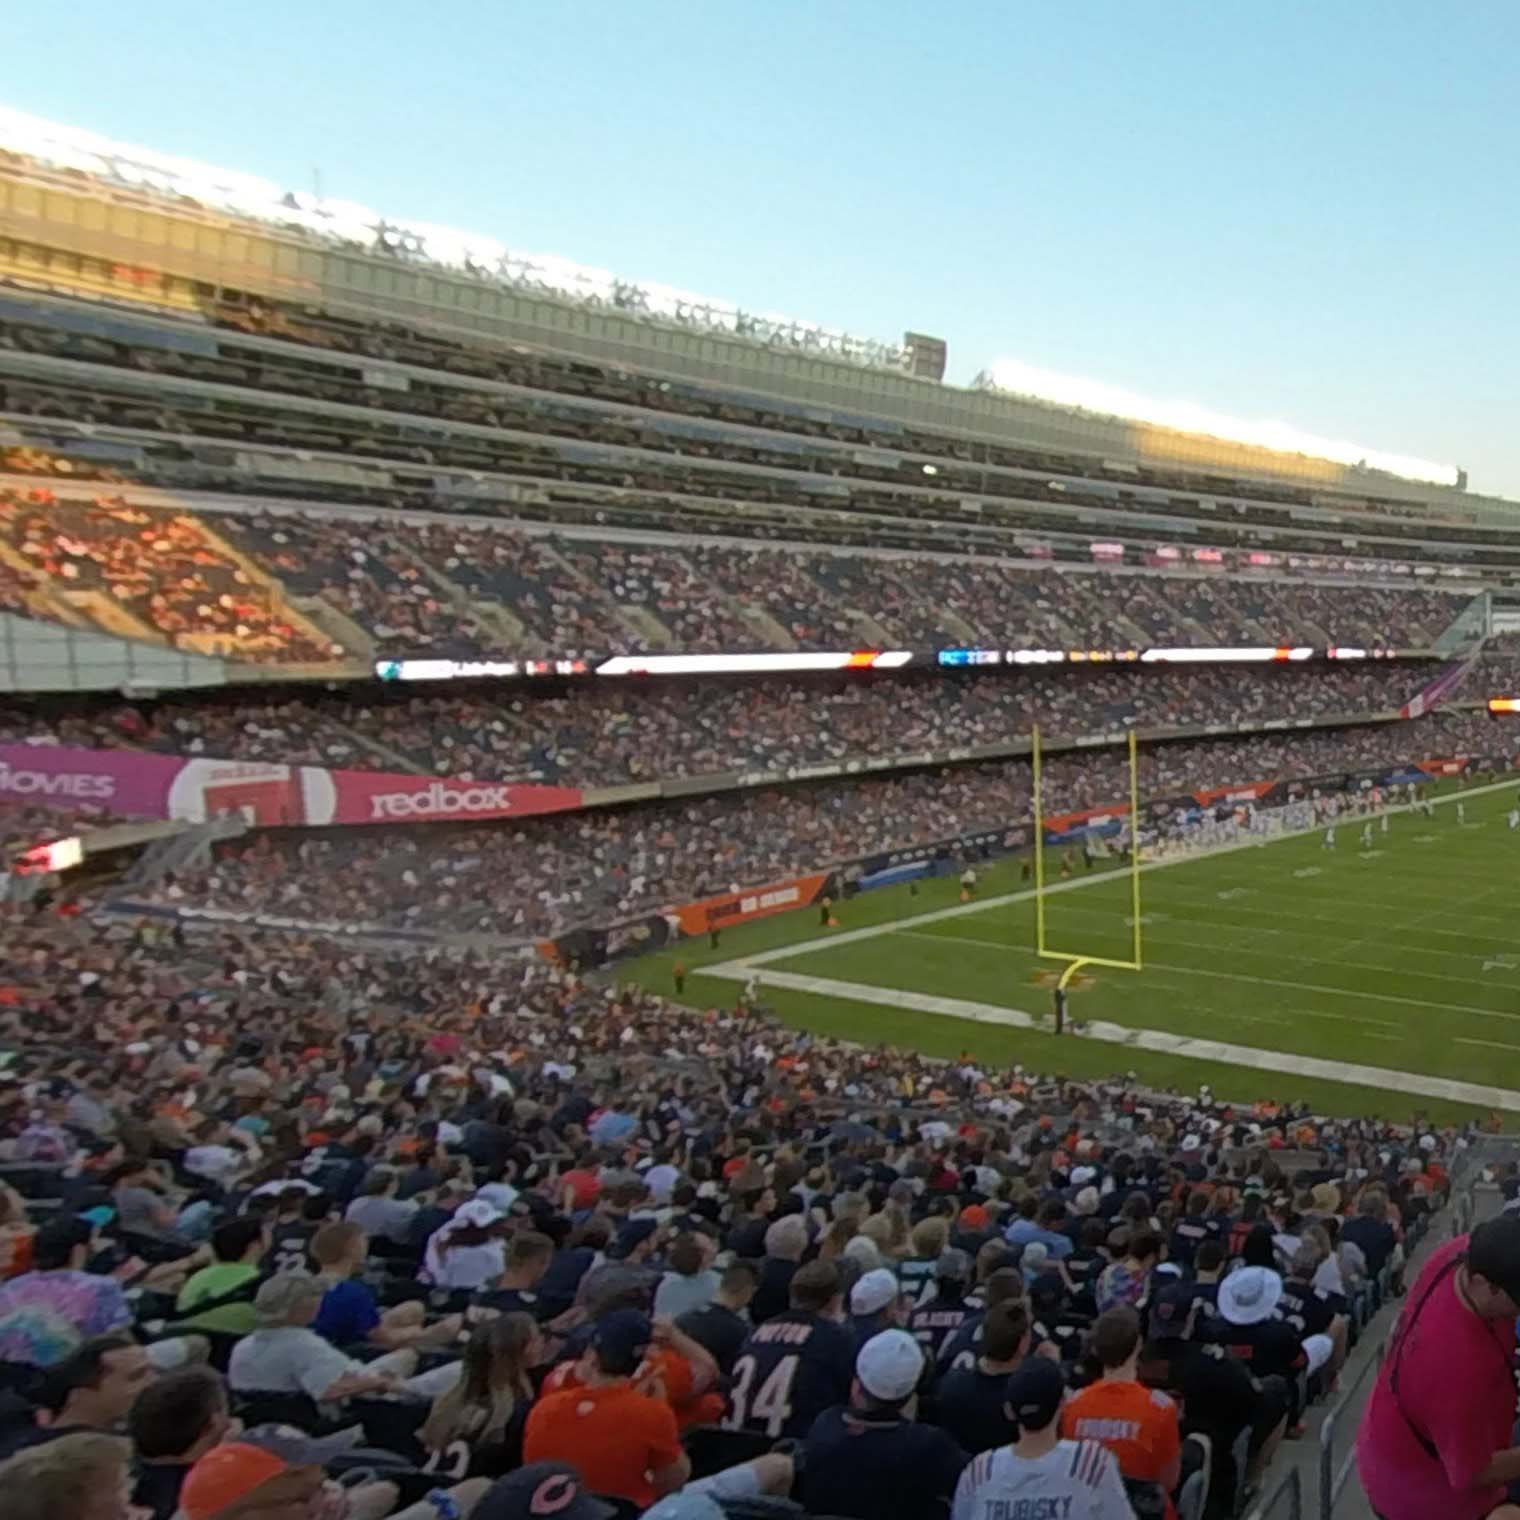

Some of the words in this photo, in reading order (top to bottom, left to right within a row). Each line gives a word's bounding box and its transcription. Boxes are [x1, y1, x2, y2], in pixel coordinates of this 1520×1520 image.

[370, 783, 512, 818] redbox
[719, 1353, 800, 1439] 34
[984, 1495, 1073, 1520] TRUBISKY
